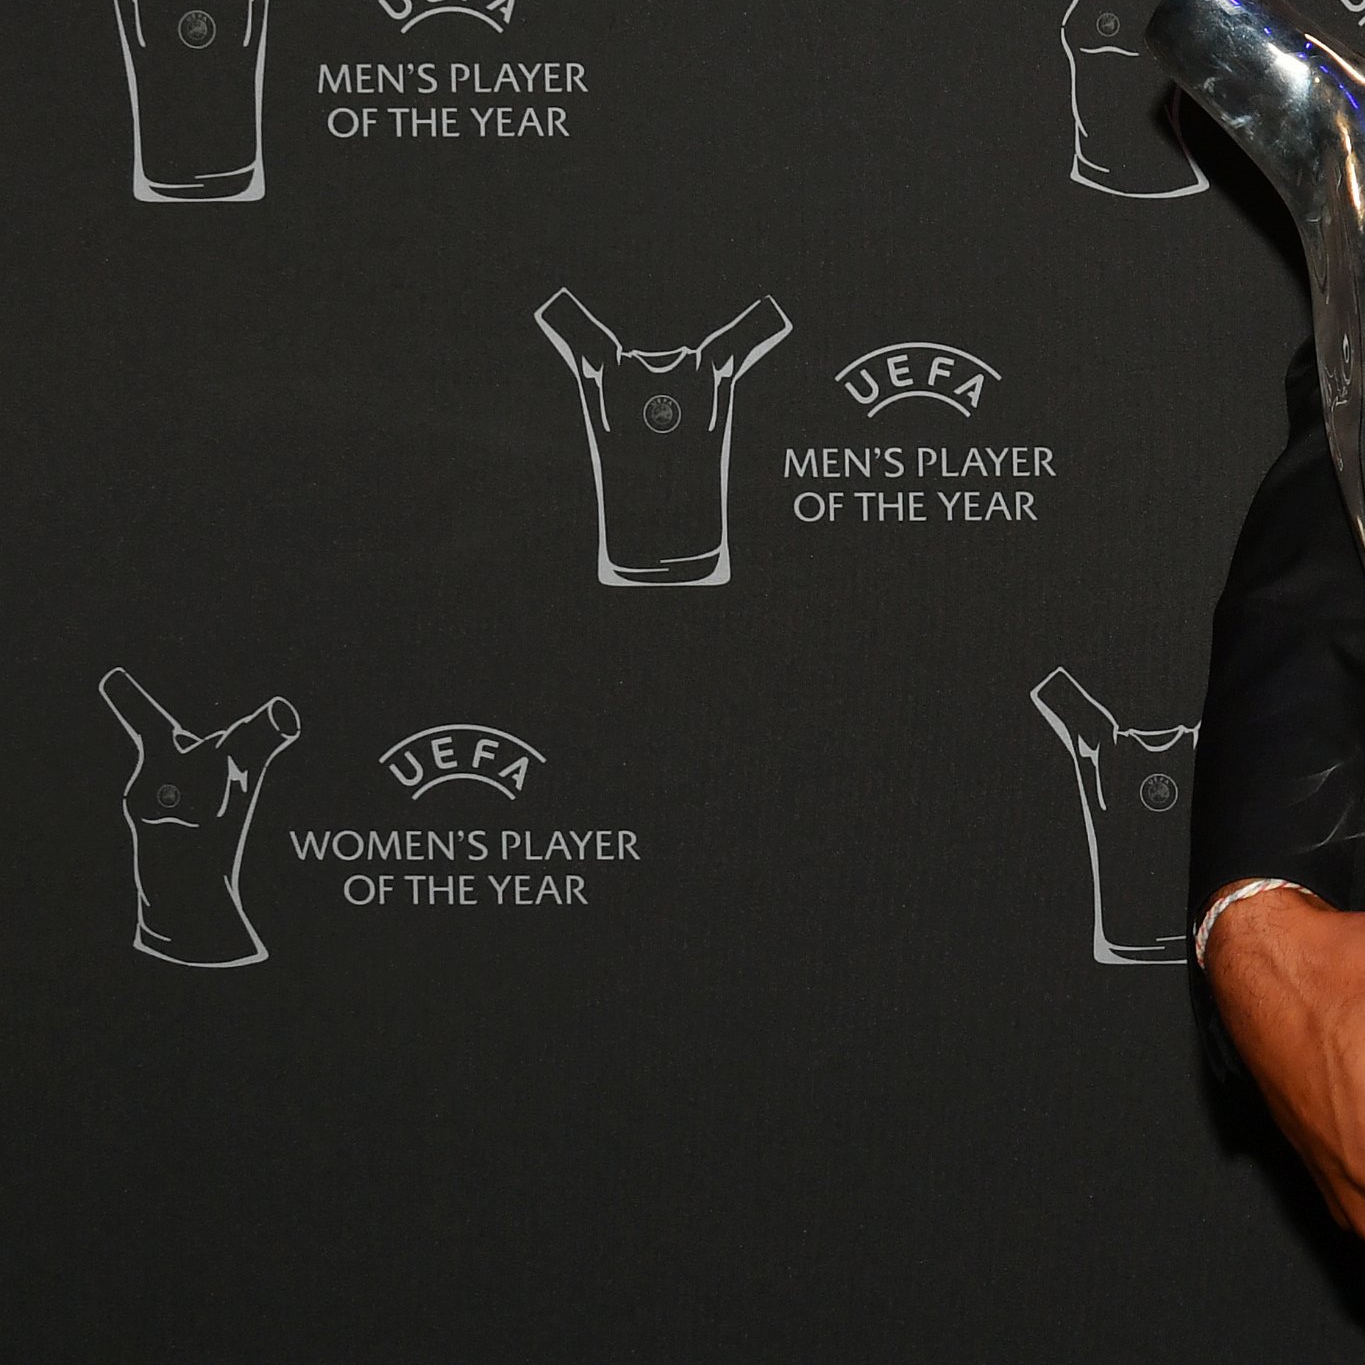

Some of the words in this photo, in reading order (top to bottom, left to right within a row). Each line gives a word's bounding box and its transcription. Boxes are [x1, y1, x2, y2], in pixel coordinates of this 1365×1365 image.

[318, 63, 437, 93] MEN'S
[451, 63, 588, 92] PLAYER
[328, 108, 377, 138] OF
[387, 108, 459, 137] THE
[470, 107, 569, 136] YEAR
[845, 355, 984, 408] UEFA
[784, 448, 904, 477] MEN'S
[918, 447, 1056, 477] PLAYER
[794, 492, 843, 522] OF
[854, 492, 926, 521] THE
[938, 492, 1037, 520] YEAR
[389, 737, 529, 790] UEFA
[290, 831, 488, 860] WOMEN'S
[502, 831, 640, 860] PLAYER
[344, 875, 394, 905] OF
[404, 876, 477, 904] THE
[488, 875, 588, 904] YEAR
